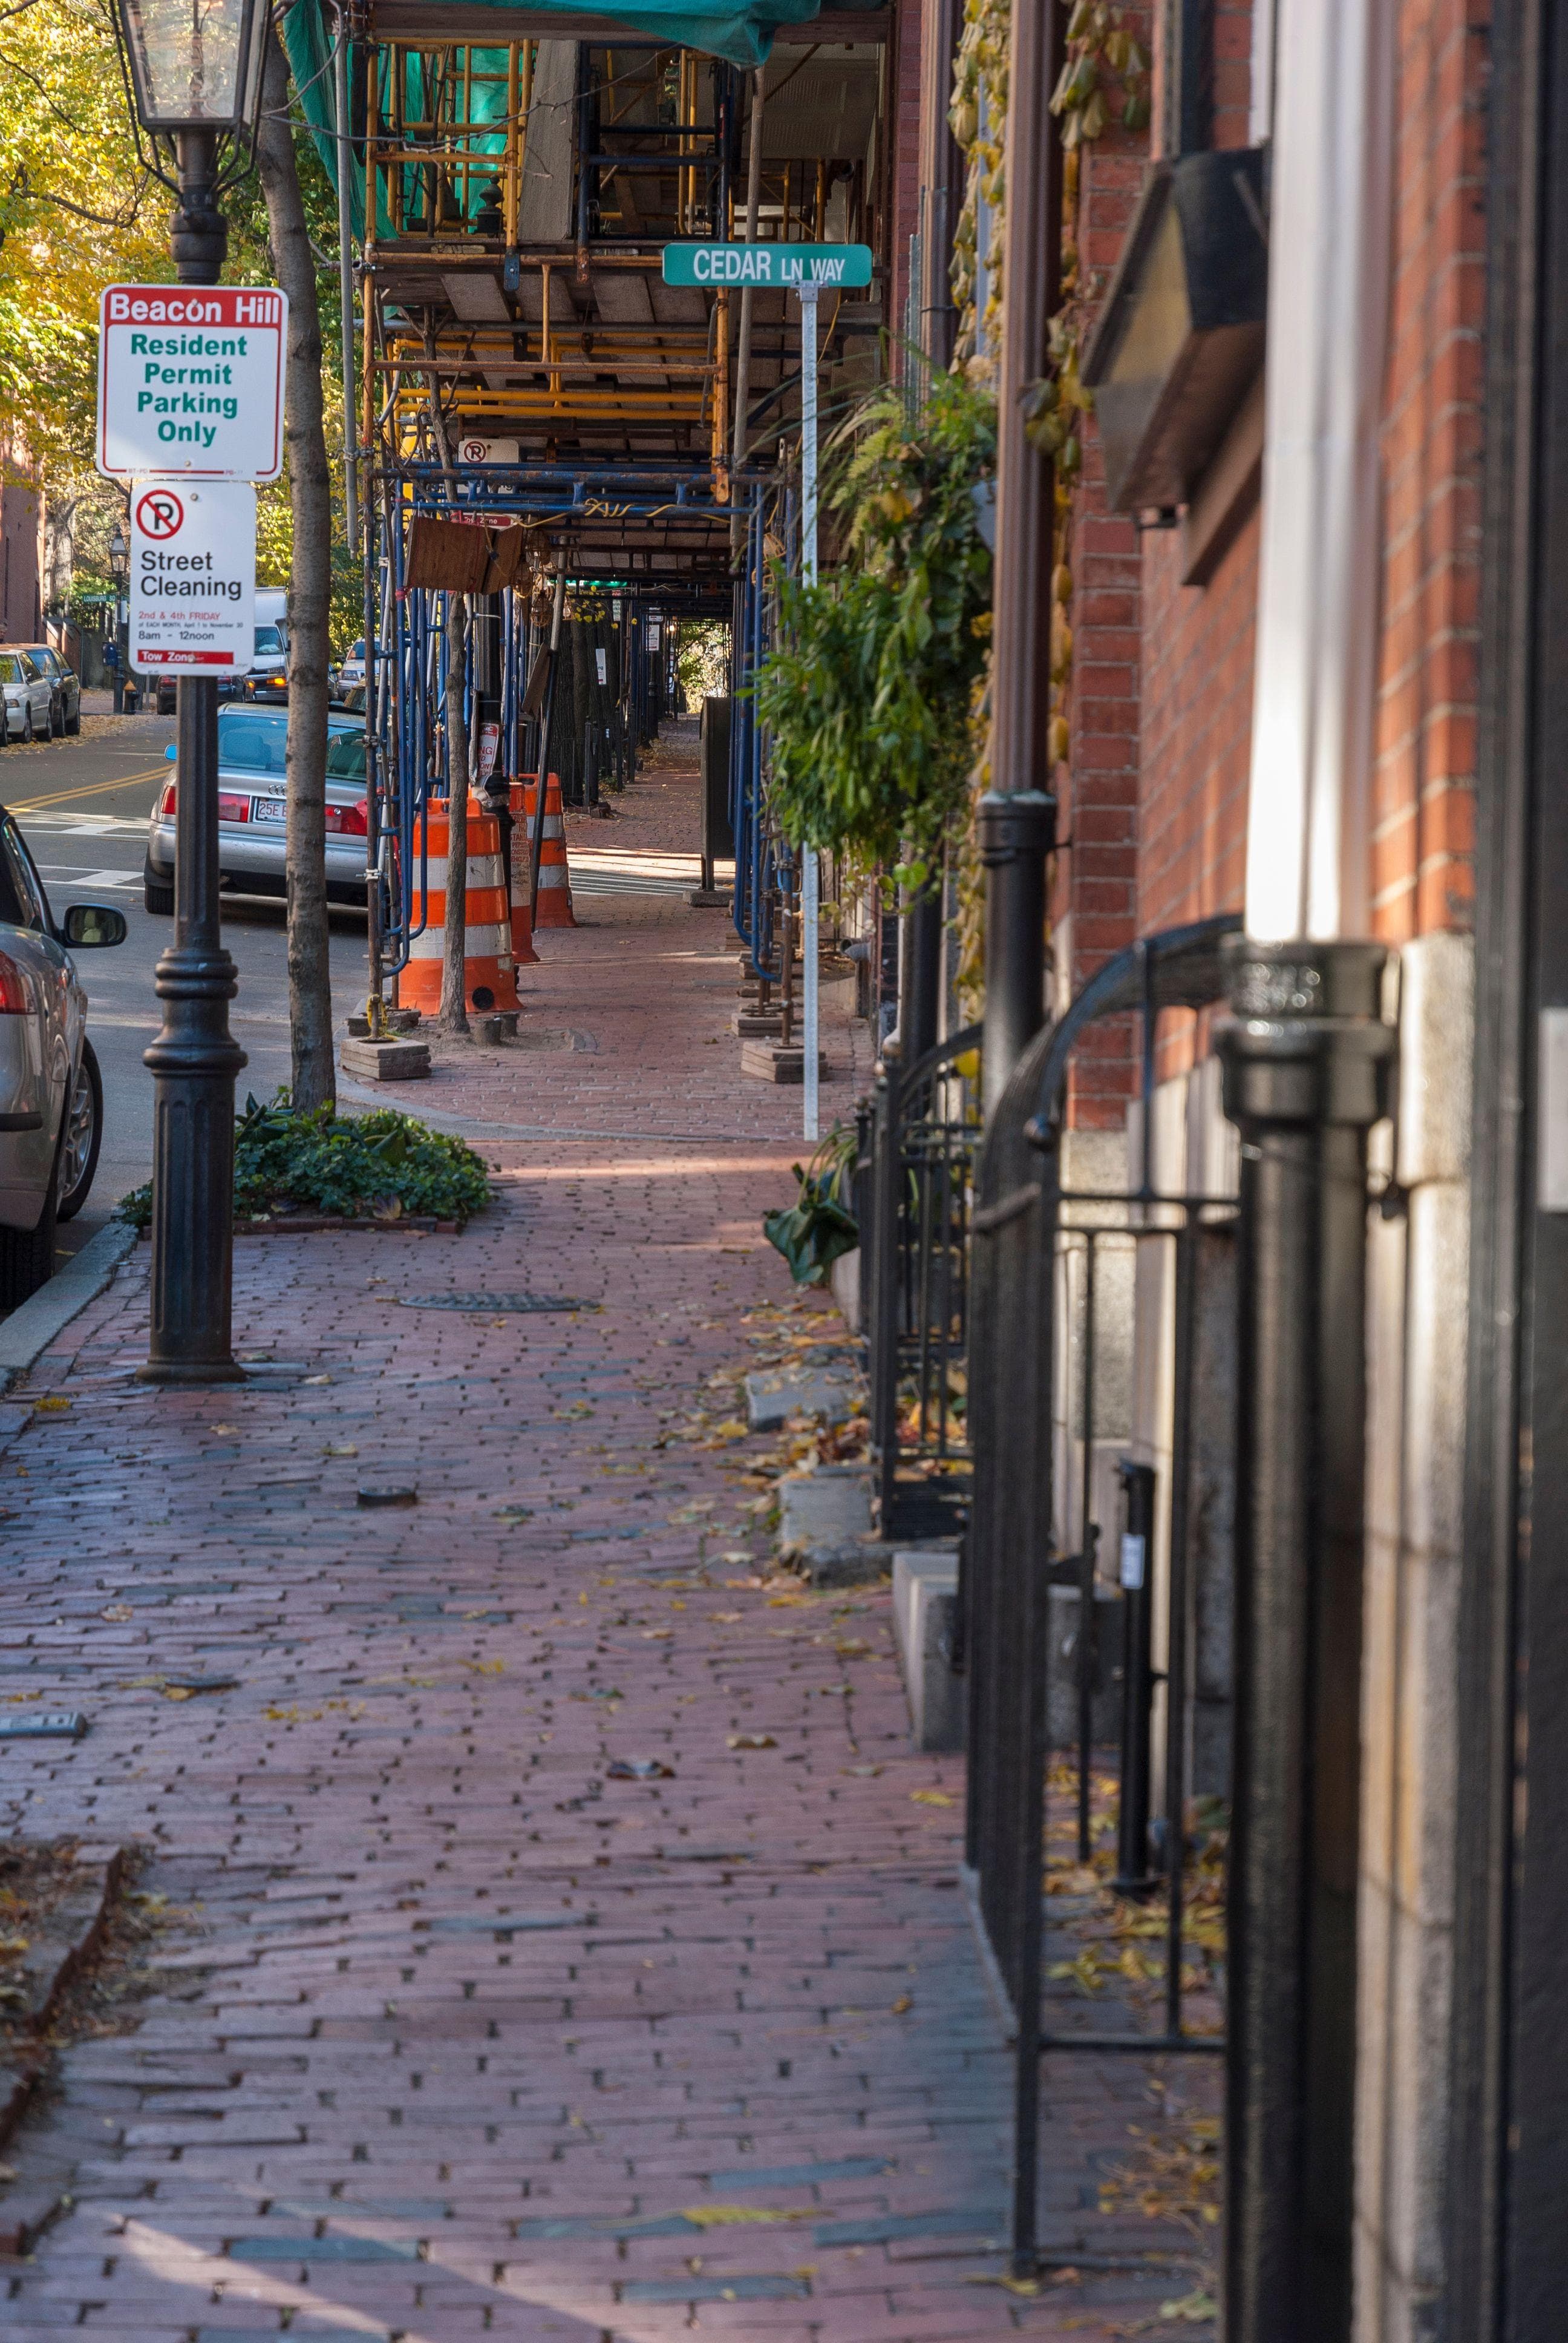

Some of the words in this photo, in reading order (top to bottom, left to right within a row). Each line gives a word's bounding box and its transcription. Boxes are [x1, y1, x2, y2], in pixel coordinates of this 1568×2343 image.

[693, 249, 771, 281] CEDAR
[782, 258, 803, 281] LN
[810, 258, 845, 281] WAY
[110, 293, 221, 323] Beacon
[235, 297, 279, 324] Hill
[131, 334, 247, 356] Resident
[145, 363, 232, 384] Permit
[137, 392, 238, 419] Parking
[157, 421, 217, 447] Only
[141, 551, 213, 571] Street
[141, 576, 241, 601] Cleaning
[139, 631, 160, 640] 8am
[179, 631, 214, 640] 12noon
[142, 651, 162, 661] Tow
[260, 803, 279, 816] 25E
